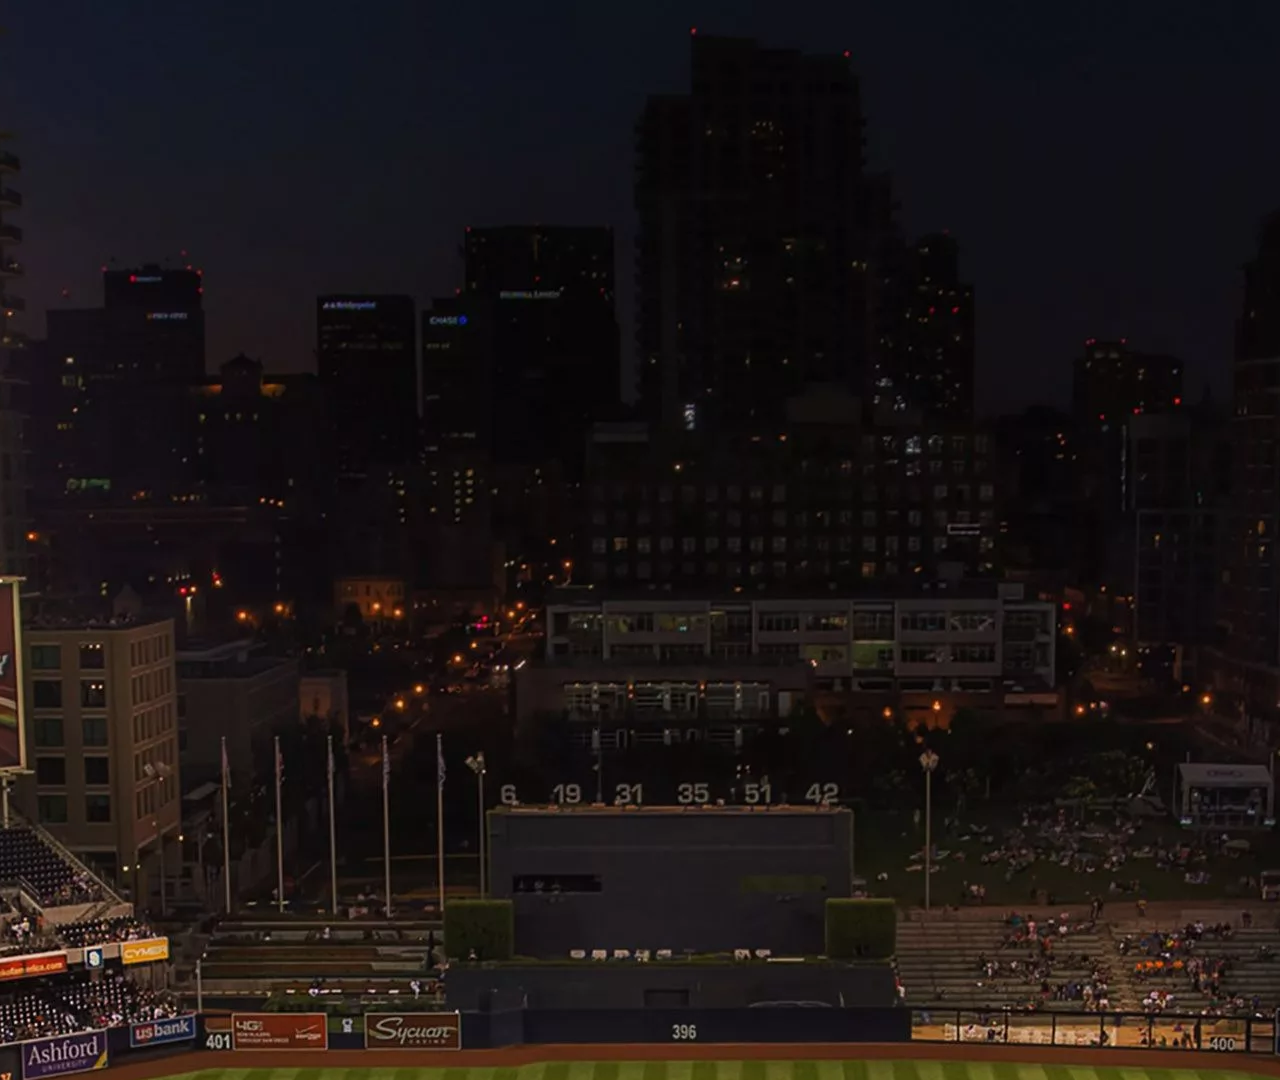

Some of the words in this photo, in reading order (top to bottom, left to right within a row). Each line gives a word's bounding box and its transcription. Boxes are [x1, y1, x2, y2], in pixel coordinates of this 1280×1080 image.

[429, 316, 457, 325] CHASE
[500, 783, 517, 803] 6
[552, 783, 581, 803] 19
[615, 783, 643, 803] 31
[677, 783, 710, 803] 35
[744, 783, 772, 803] 51
[805, 783, 839, 803] 42
[376, 1017, 451, 1044] Sycuan
[672, 1024, 697, 1040] 396
[206, 1034, 231, 1049] 401
[1210, 1037, 1235, 1051] 400
[28, 1037, 99, 1066] Ashford
